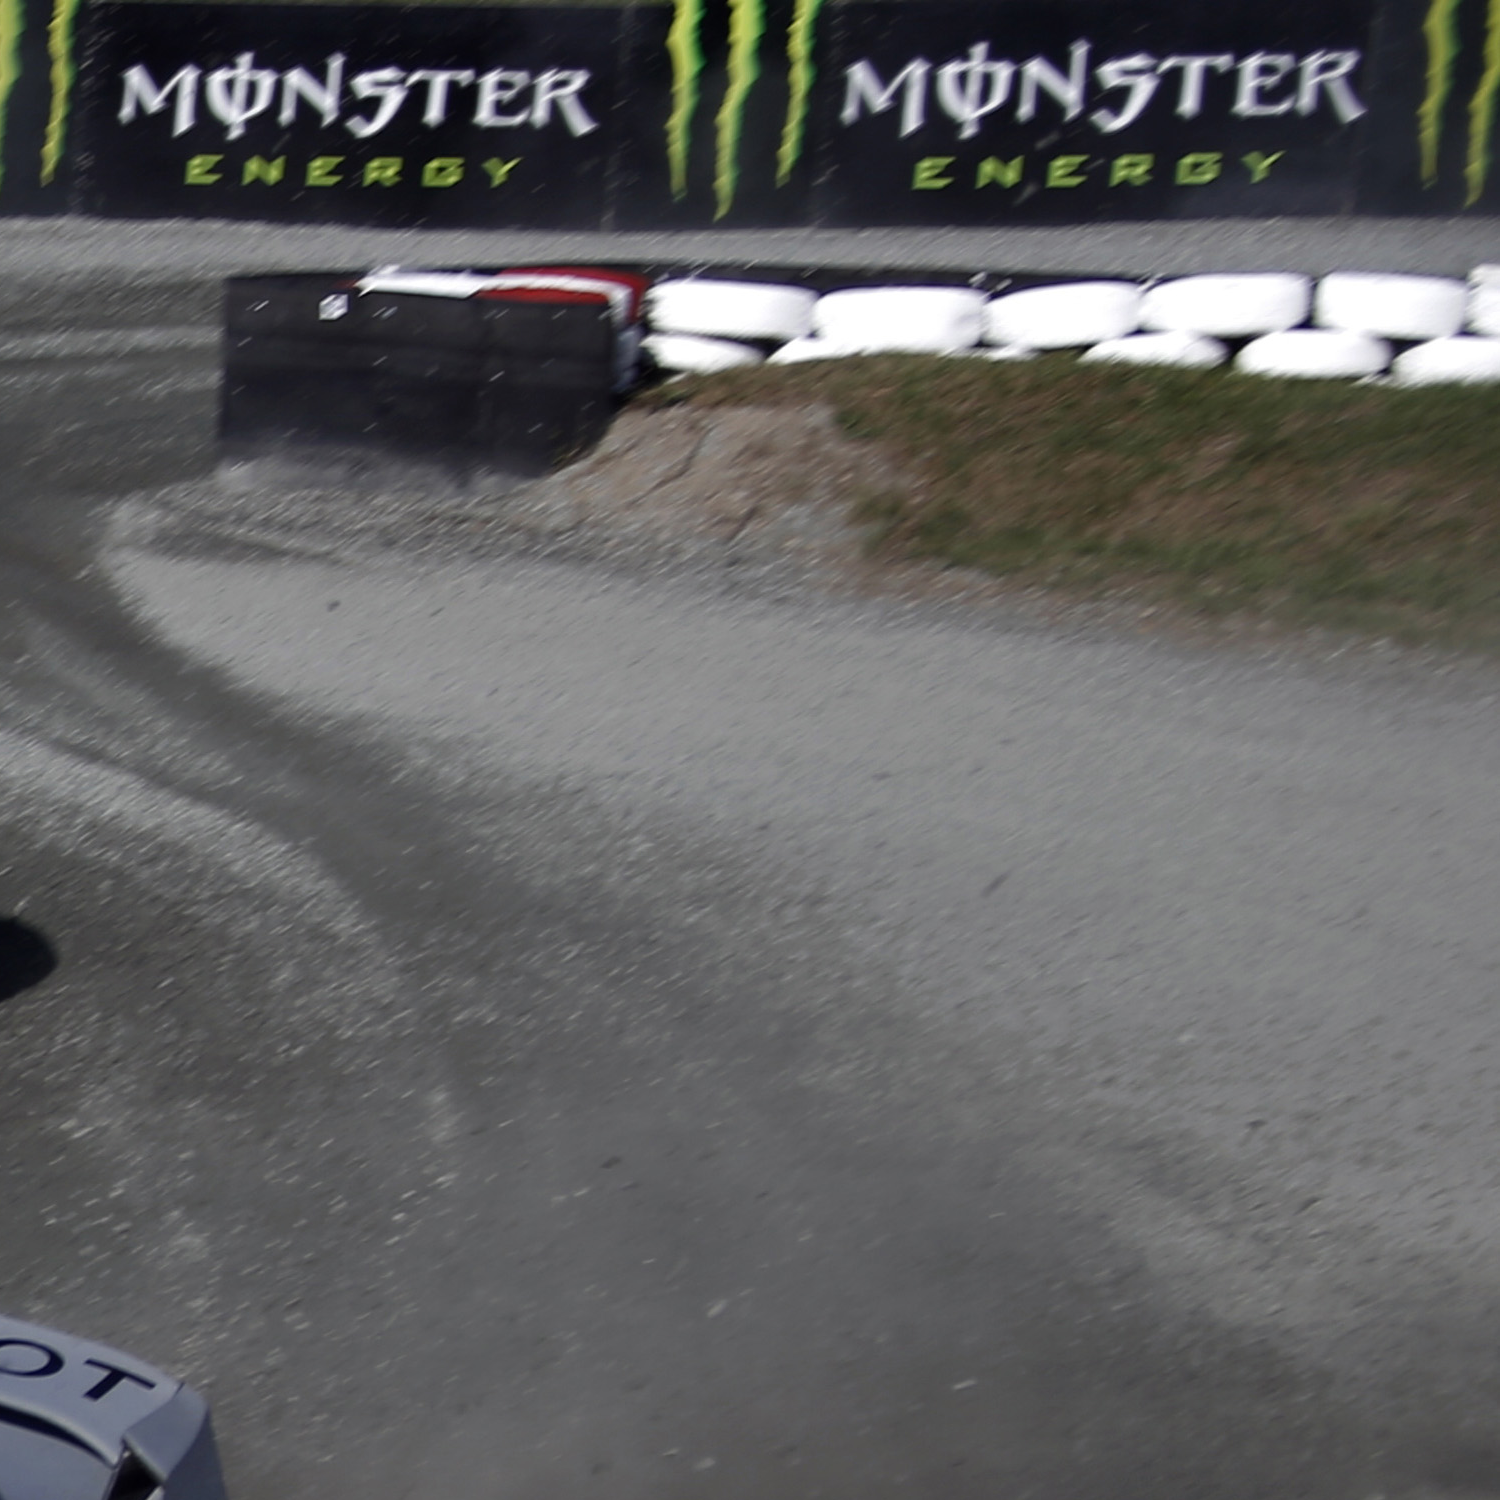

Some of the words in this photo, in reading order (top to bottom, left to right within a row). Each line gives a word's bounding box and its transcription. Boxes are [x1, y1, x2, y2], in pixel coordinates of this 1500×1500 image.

[119, 52, 599, 138] MONSTER
[842, 41, 1369, 138] MONSTER
[185, 155, 522, 190] ENERGY
[912, 150, 1287, 191] ENERGY
